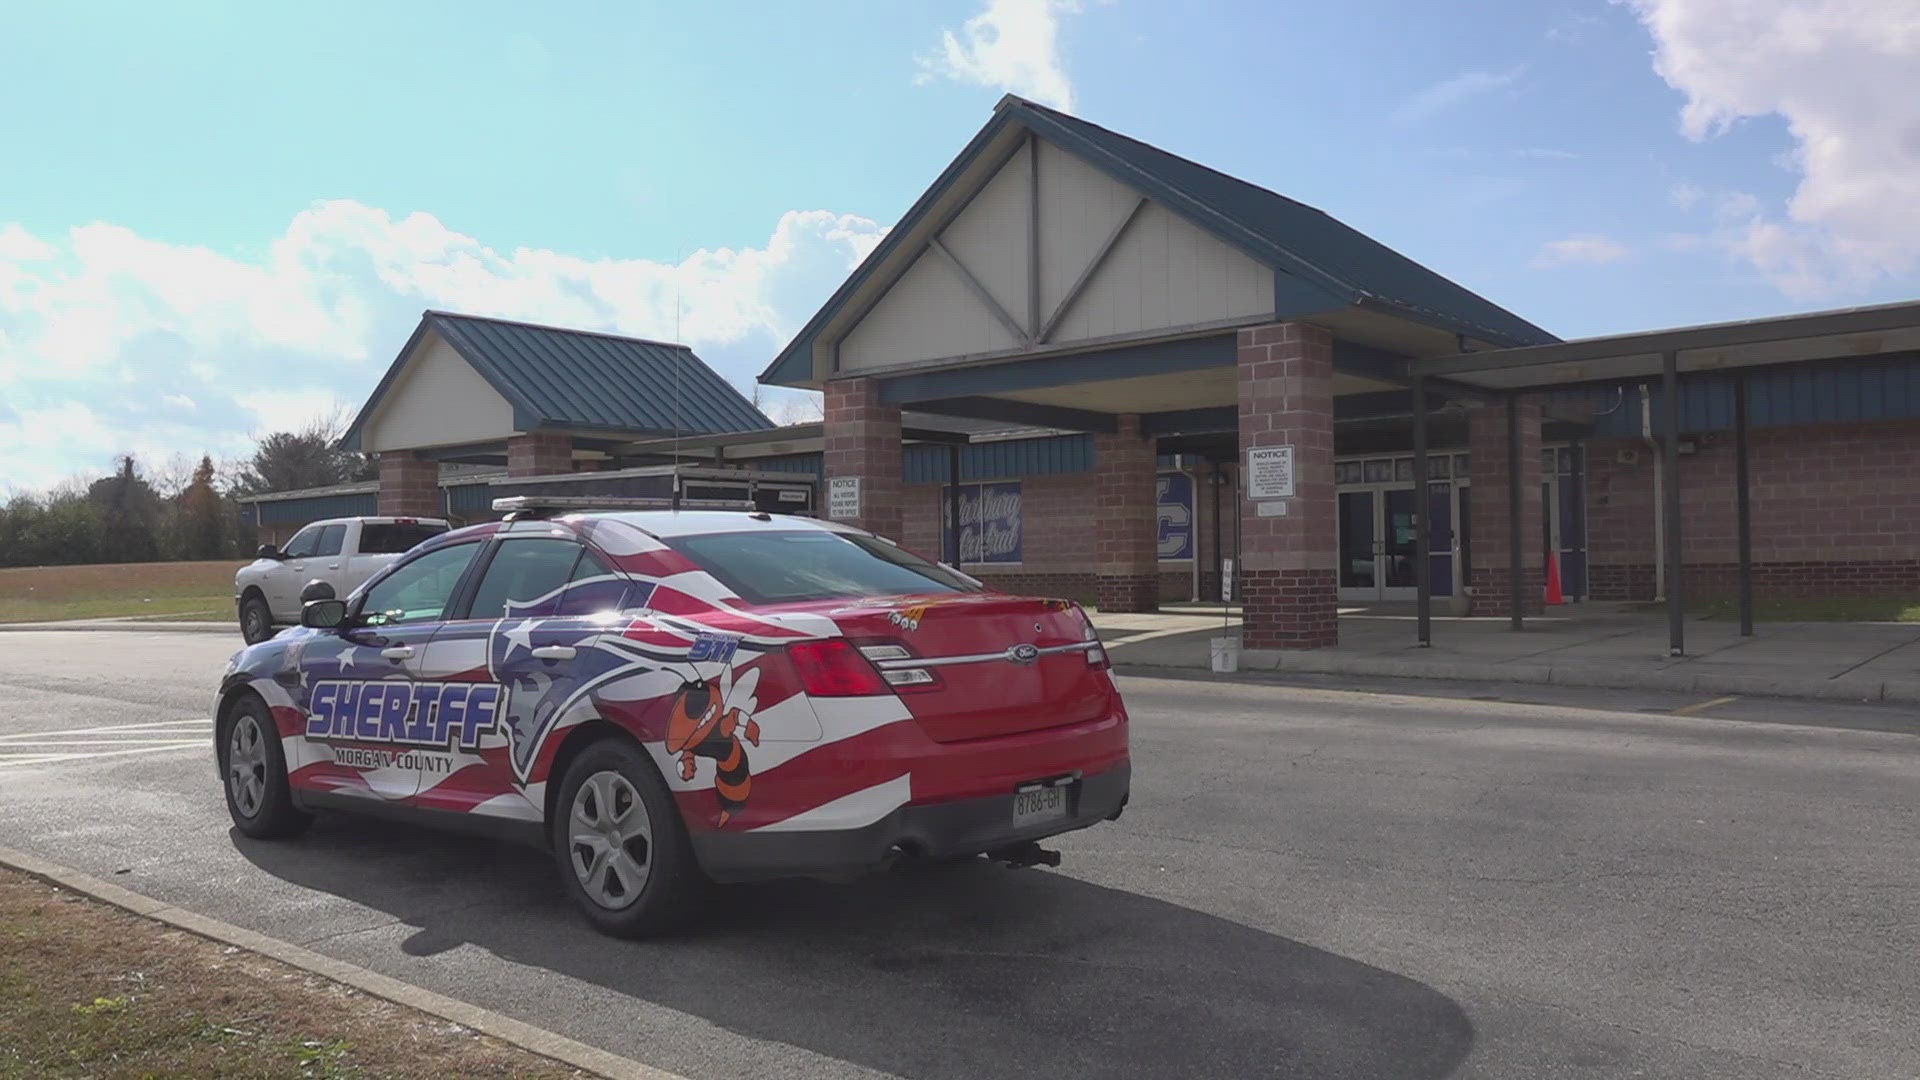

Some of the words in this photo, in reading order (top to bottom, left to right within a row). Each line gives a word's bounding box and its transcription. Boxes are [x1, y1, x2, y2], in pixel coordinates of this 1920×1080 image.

[1253, 450, 1288, 459] NOTICE
[832, 480, 857, 488] NOTICE
[687, 639, 738, 663] 911
[1019, 646, 1036, 658] Ford
[306, 680, 501, 748] SHERIFF
[335, 749, 393, 768] MORGAN
[396, 753, 454, 772] COUNTY
